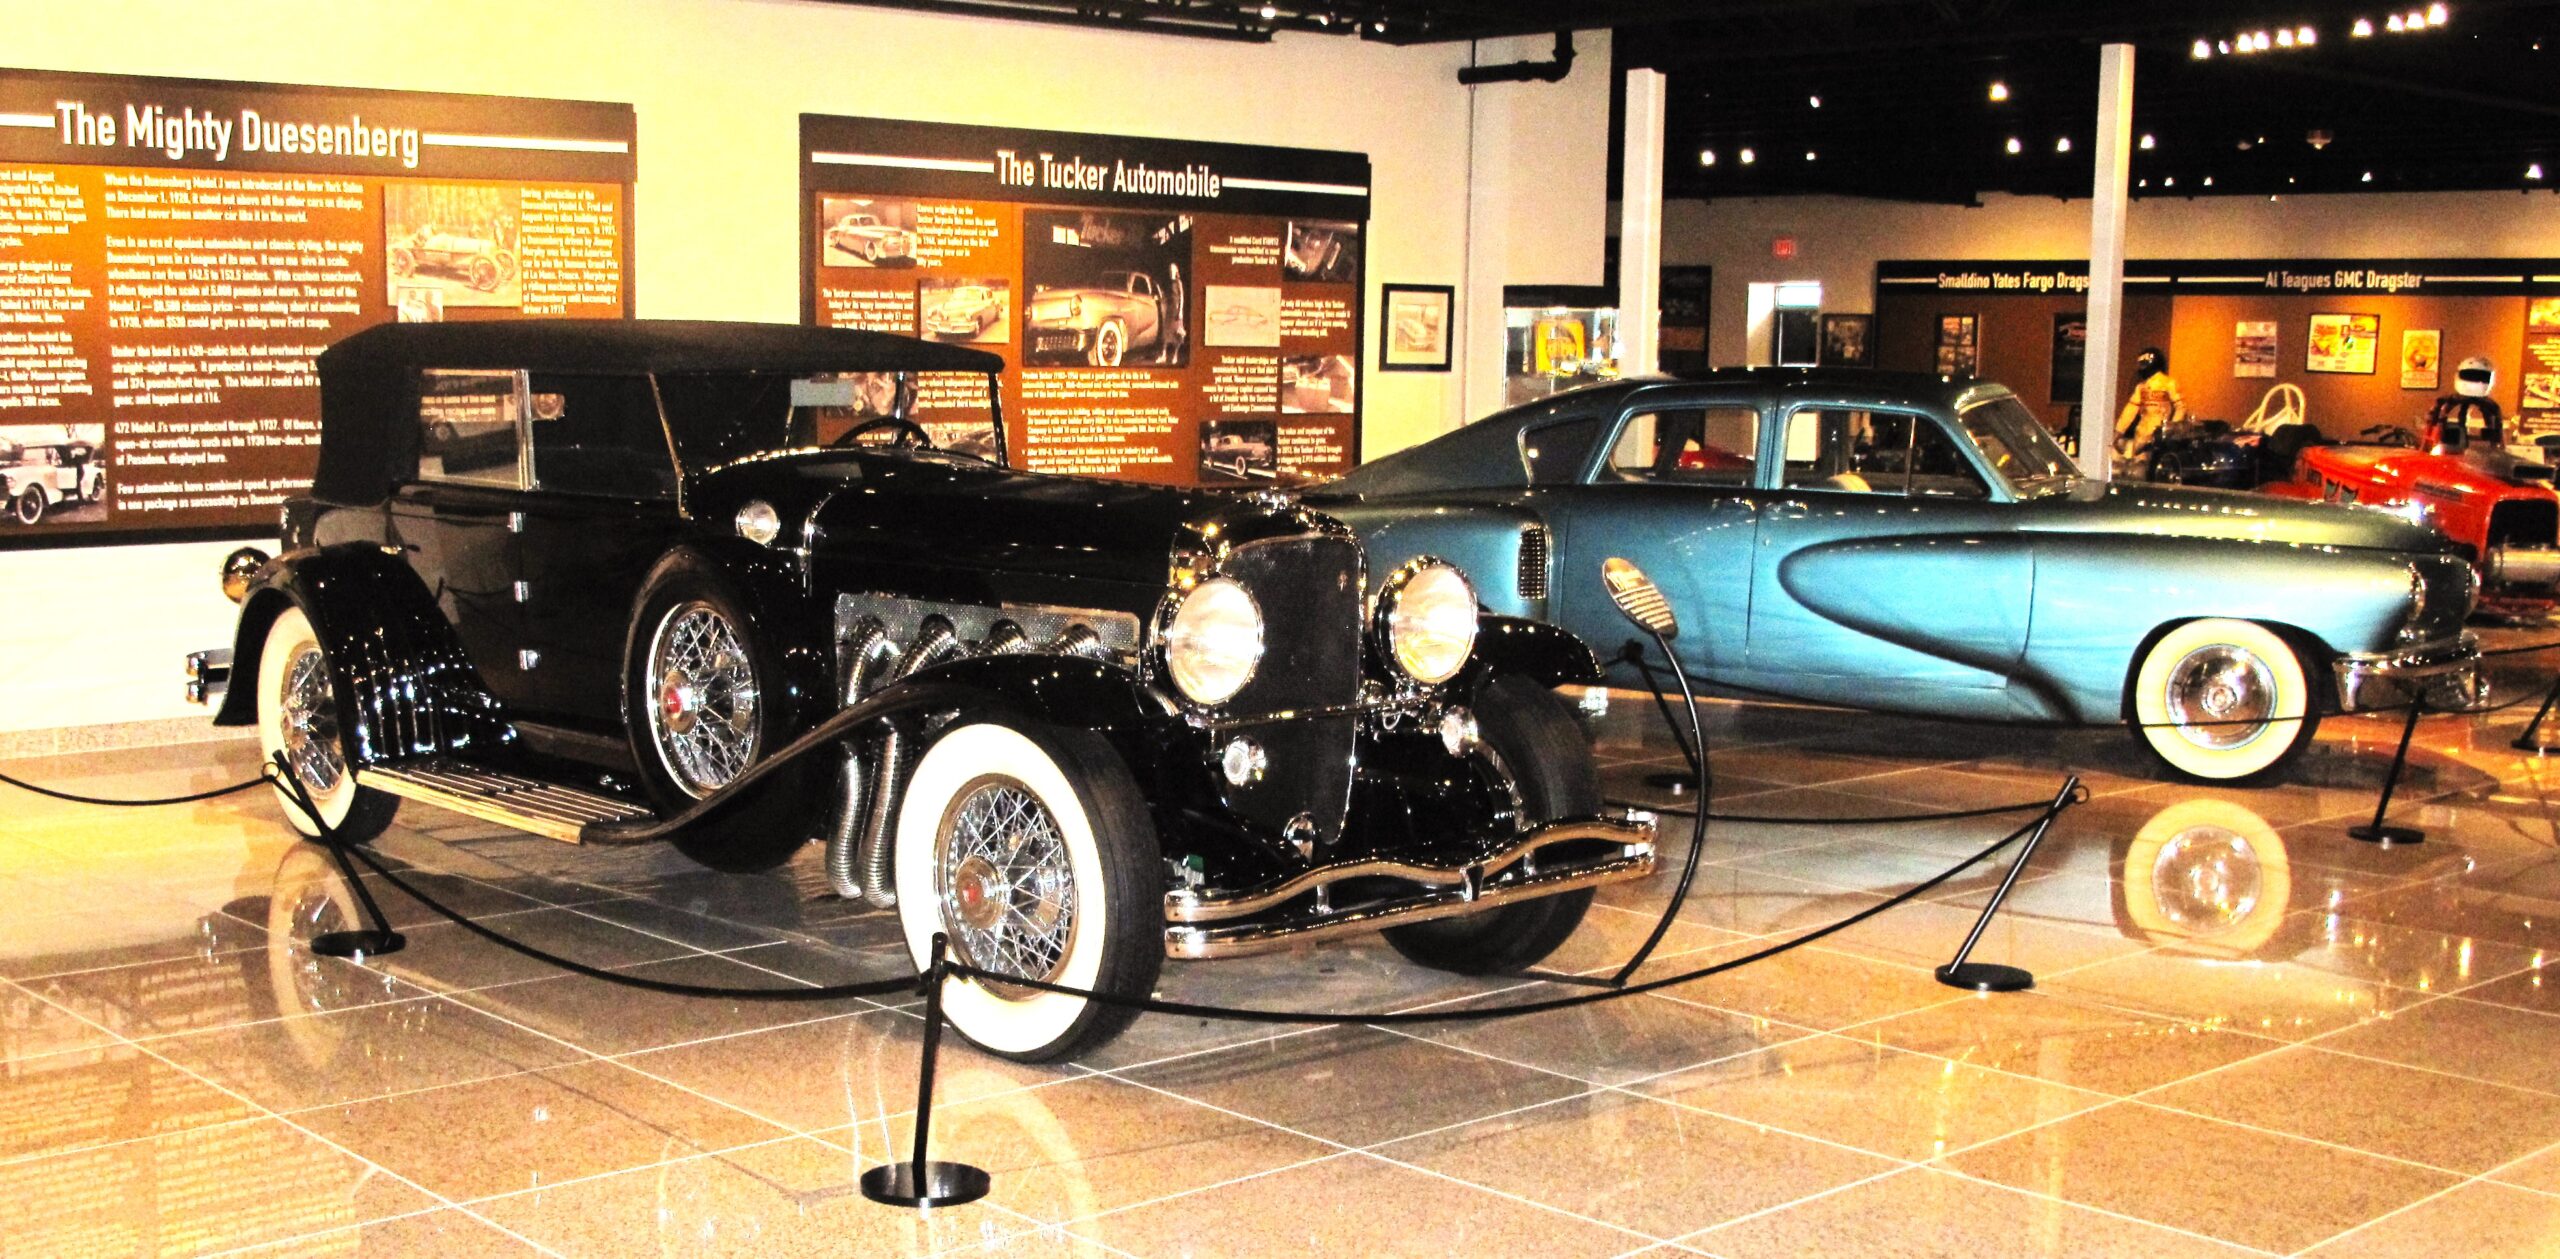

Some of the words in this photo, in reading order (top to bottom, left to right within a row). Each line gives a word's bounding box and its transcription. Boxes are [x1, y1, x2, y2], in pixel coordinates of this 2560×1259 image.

[56, 101, 116, 146] The
[126, 103, 233, 161] Mighty
[242, 109, 420, 168] Duesenberg
[997, 150, 1034, 186] The
[1040, 152, 1107, 191] Tucker
[1113, 160, 1220, 198] Automobile
[1938, 273, 1990, 289] Smalldino
[1992, 273, 2020, 289] Yates
[2024, 272, 2054, 292] Fargo
[2057, 272, 2090, 293] Drags
[2265, 271, 2278, 288] Al
[2282, 271, 2331, 292] Teagues
[2335, 271, 2364, 288] GMC
[2367, 270, 2422, 293] Dragster
